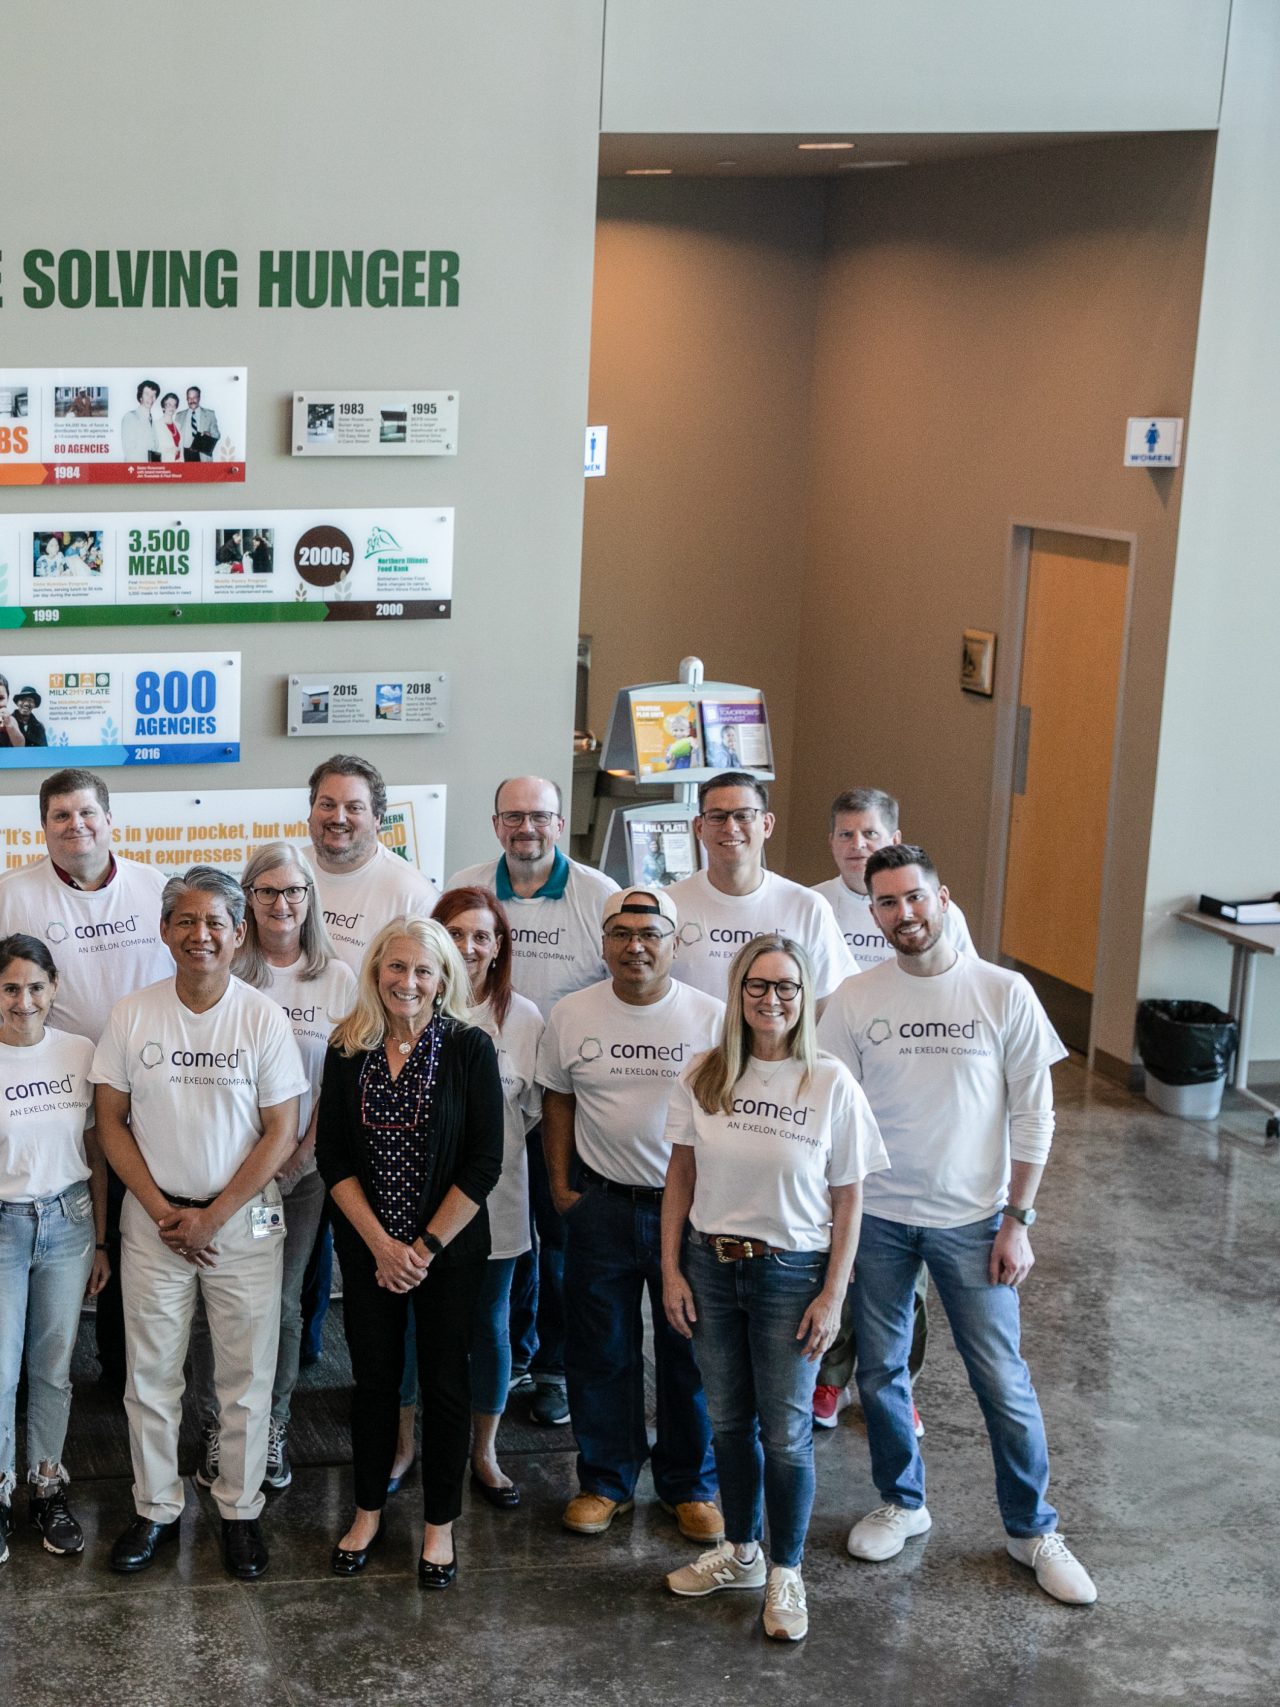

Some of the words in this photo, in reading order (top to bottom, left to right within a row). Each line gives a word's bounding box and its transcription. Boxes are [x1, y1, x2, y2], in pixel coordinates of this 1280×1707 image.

[23, 248, 238, 309] SOLVING
[259, 249, 460, 308] HUNGER
[339, 403, 364, 414] 1983
[412, 403, 437, 414] 1995
[54, 444, 66, 453] 80
[68, 443, 110, 453] AGENCIES
[54, 466, 80, 479] 1984
[129, 529, 190, 554] 3,500
[299, 546, 350, 566] 2000s
[128, 555, 189, 576] MEALS
[33, 609, 59, 622] 1999
[376, 603, 403, 616] 2000
[135, 670, 216, 715] 800
[333, 684, 357, 696] 2015
[406, 683, 431, 694] 2018
[135, 717, 216, 736] AGENCIES
[135, 748, 160, 760] 2016
[126, 825, 141, 842] in
[145, 825, 183, 843] your
[187, 822, 248, 843] pocket,
[252, 821, 278, 838] but
[631, 823, 644, 833] THE
[645, 823, 663, 833] FULL
[663, 822, 687, 832] PLATE
[155, 847, 242, 865] expresses
[75, 915, 136, 939] comed
[323, 910, 359, 929] med
[91, 942, 119, 952] EXELON
[121, 937, 156, 947] COMPANY
[332, 933, 366, 948] COMPANY
[539, 951, 575, 961] COMPANY
[899, 1019, 974, 1039] comed
[171, 1048, 239, 1068] comed
[610, 1042, 683, 1062] comed
[915, 1046, 948, 1054] EXELON
[951, 1047, 992, 1057] COMPANY
[625, 1067, 658, 1076] EXELON
[5, 1074, 72, 1101] comed
[184, 1076, 214, 1085] EXELON
[217, 1077, 252, 1086] COMPAN
[24, 1103, 56, 1115] EXELON
[732, 1098, 807, 1125] comed
[742, 1123, 777, 1135] EXELON
[779, 1130, 823, 1147] COMPANY
